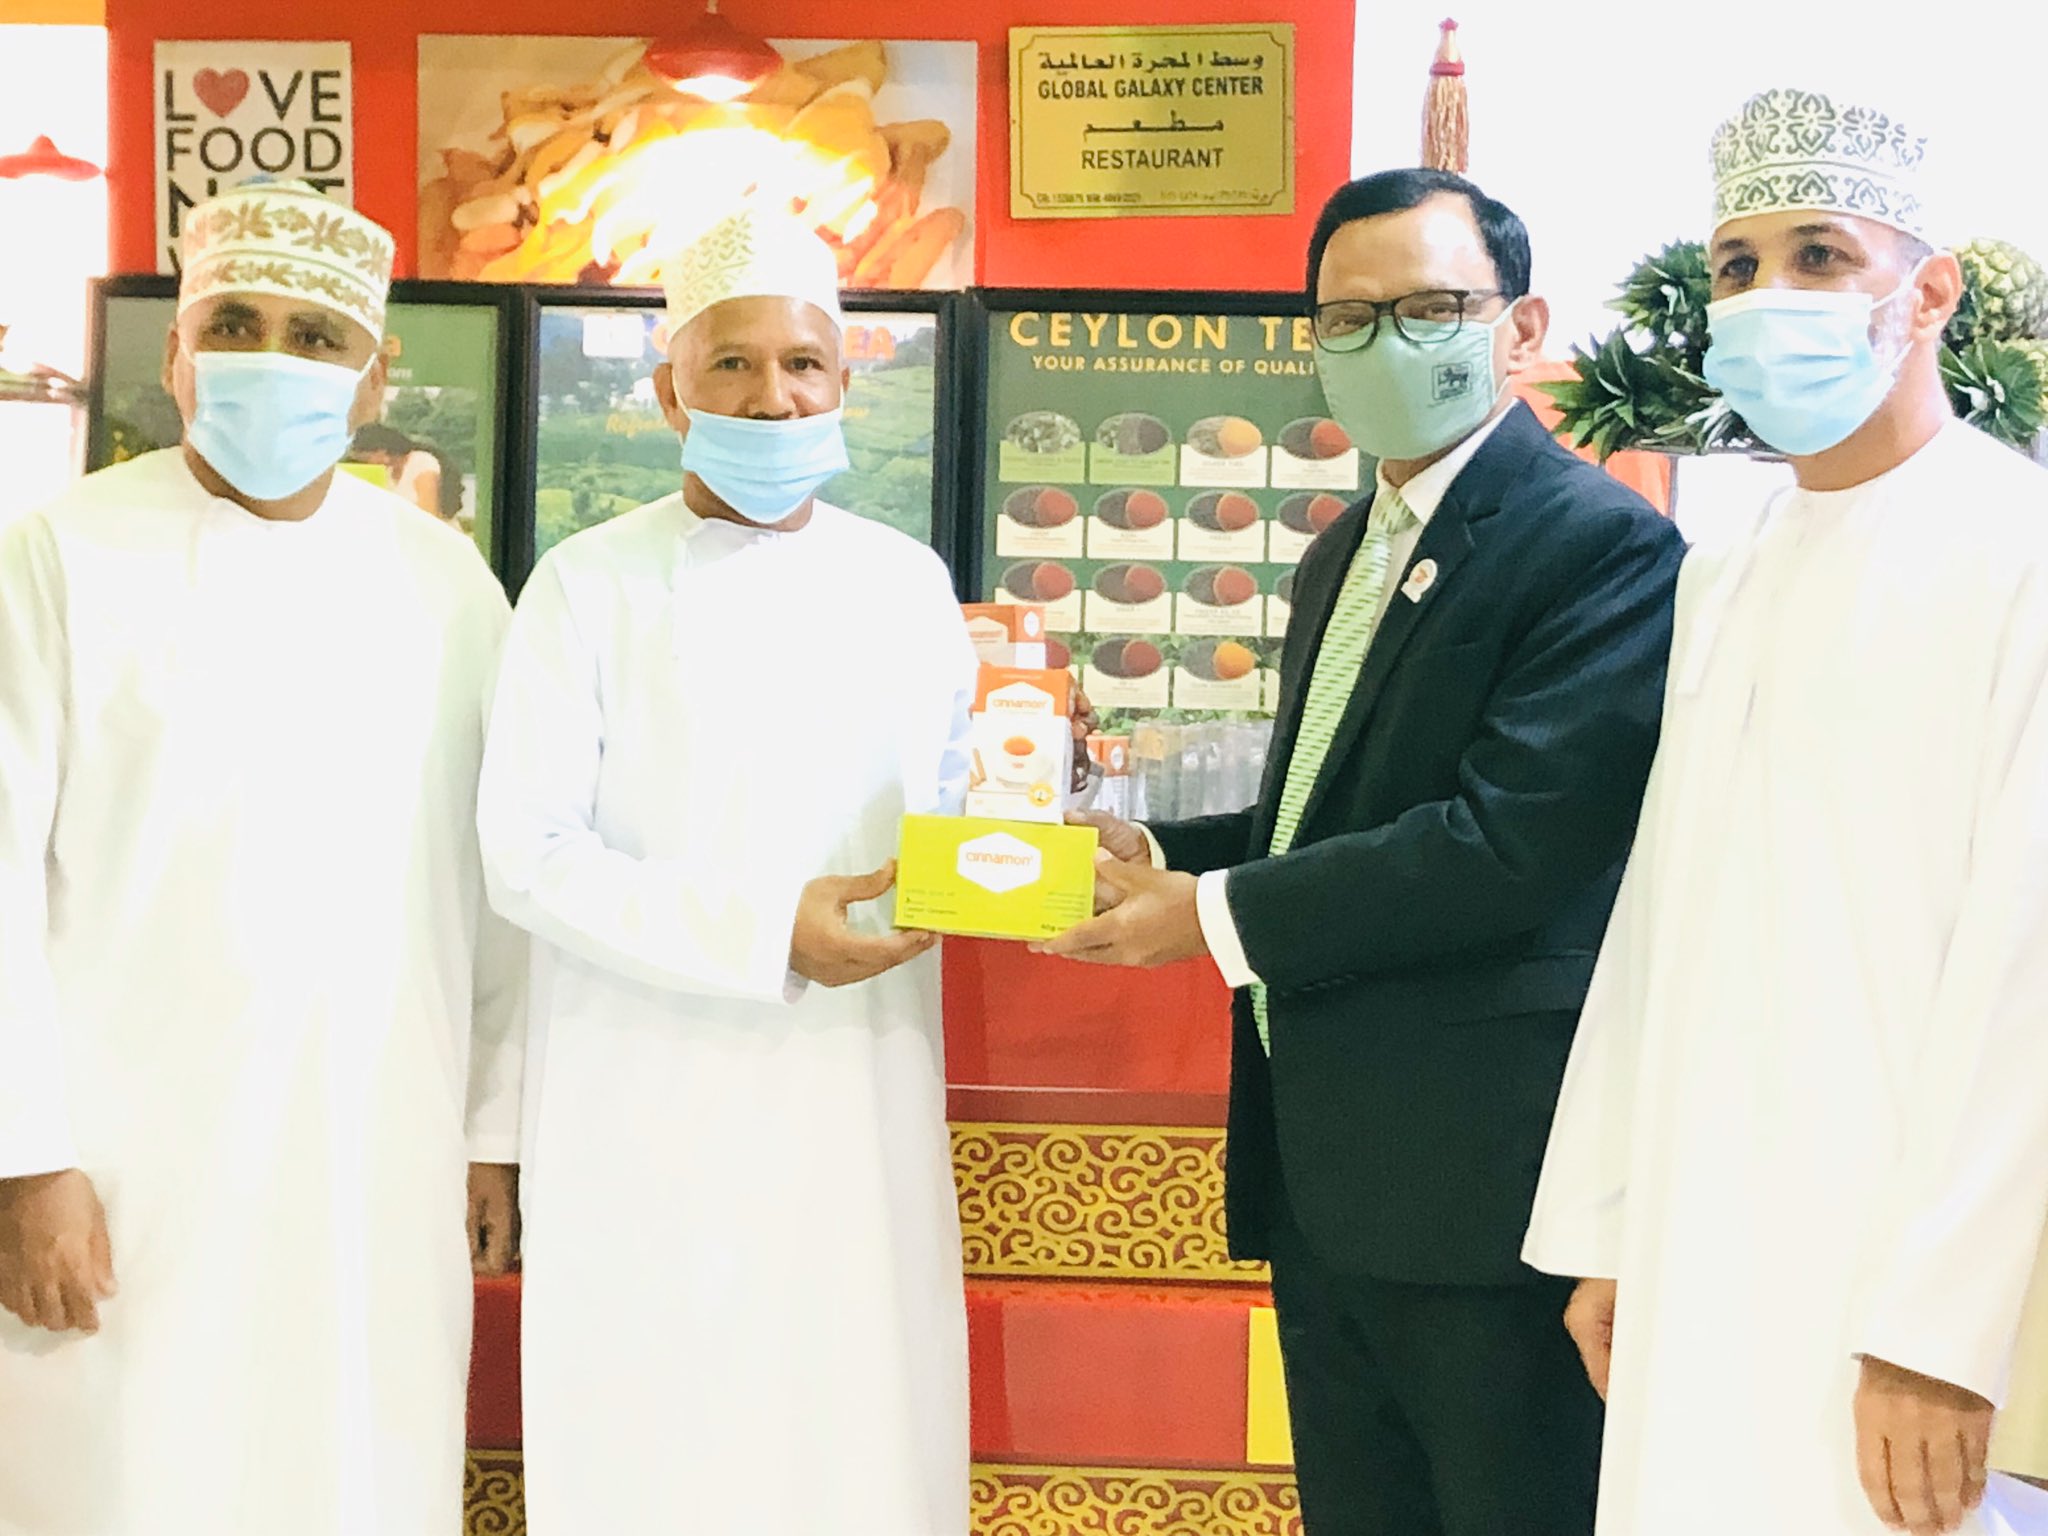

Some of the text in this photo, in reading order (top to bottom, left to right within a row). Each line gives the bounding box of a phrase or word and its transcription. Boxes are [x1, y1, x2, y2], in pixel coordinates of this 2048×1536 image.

[1038, 52, 1125, 75] العالمية
[1211, 51, 1264, 70] وسط
[1038, 76, 1264, 99] GLOBAL GALAXY CENTER
[167, 126, 342, 173] FOOD
[1082, 149, 1224, 170] RESTAURANT
[844, 325, 896, 359] EA
[1009, 312, 1312, 351] CEYLON TE
[1032, 355, 1315, 375] YOUR ASSURANCE OF QUALI
[967, 852, 1031, 866] cinnamon
